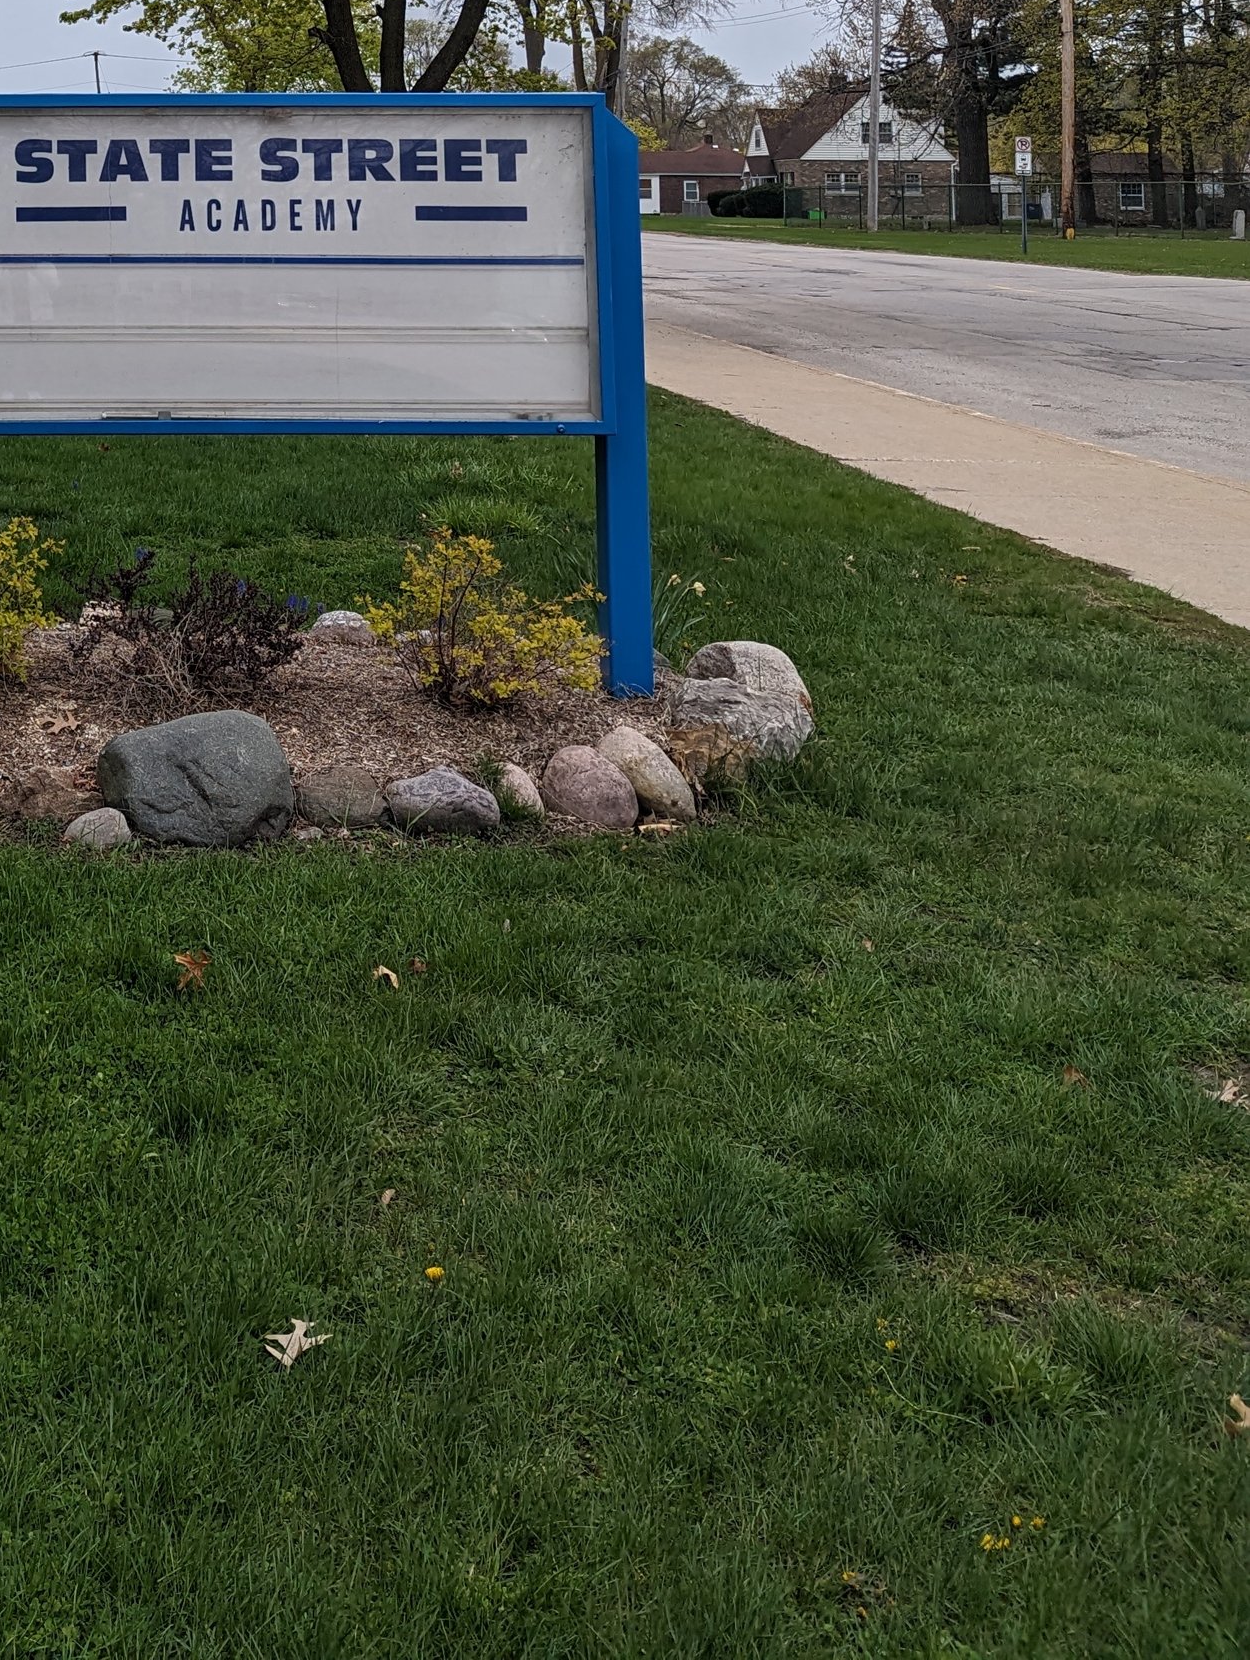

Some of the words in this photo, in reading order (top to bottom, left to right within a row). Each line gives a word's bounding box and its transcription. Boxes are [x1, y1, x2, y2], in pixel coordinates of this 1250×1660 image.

[14, 138, 234, 183] STATE
[259, 137, 529, 183] STREET
[179, 198, 363, 232] ACADEMY
